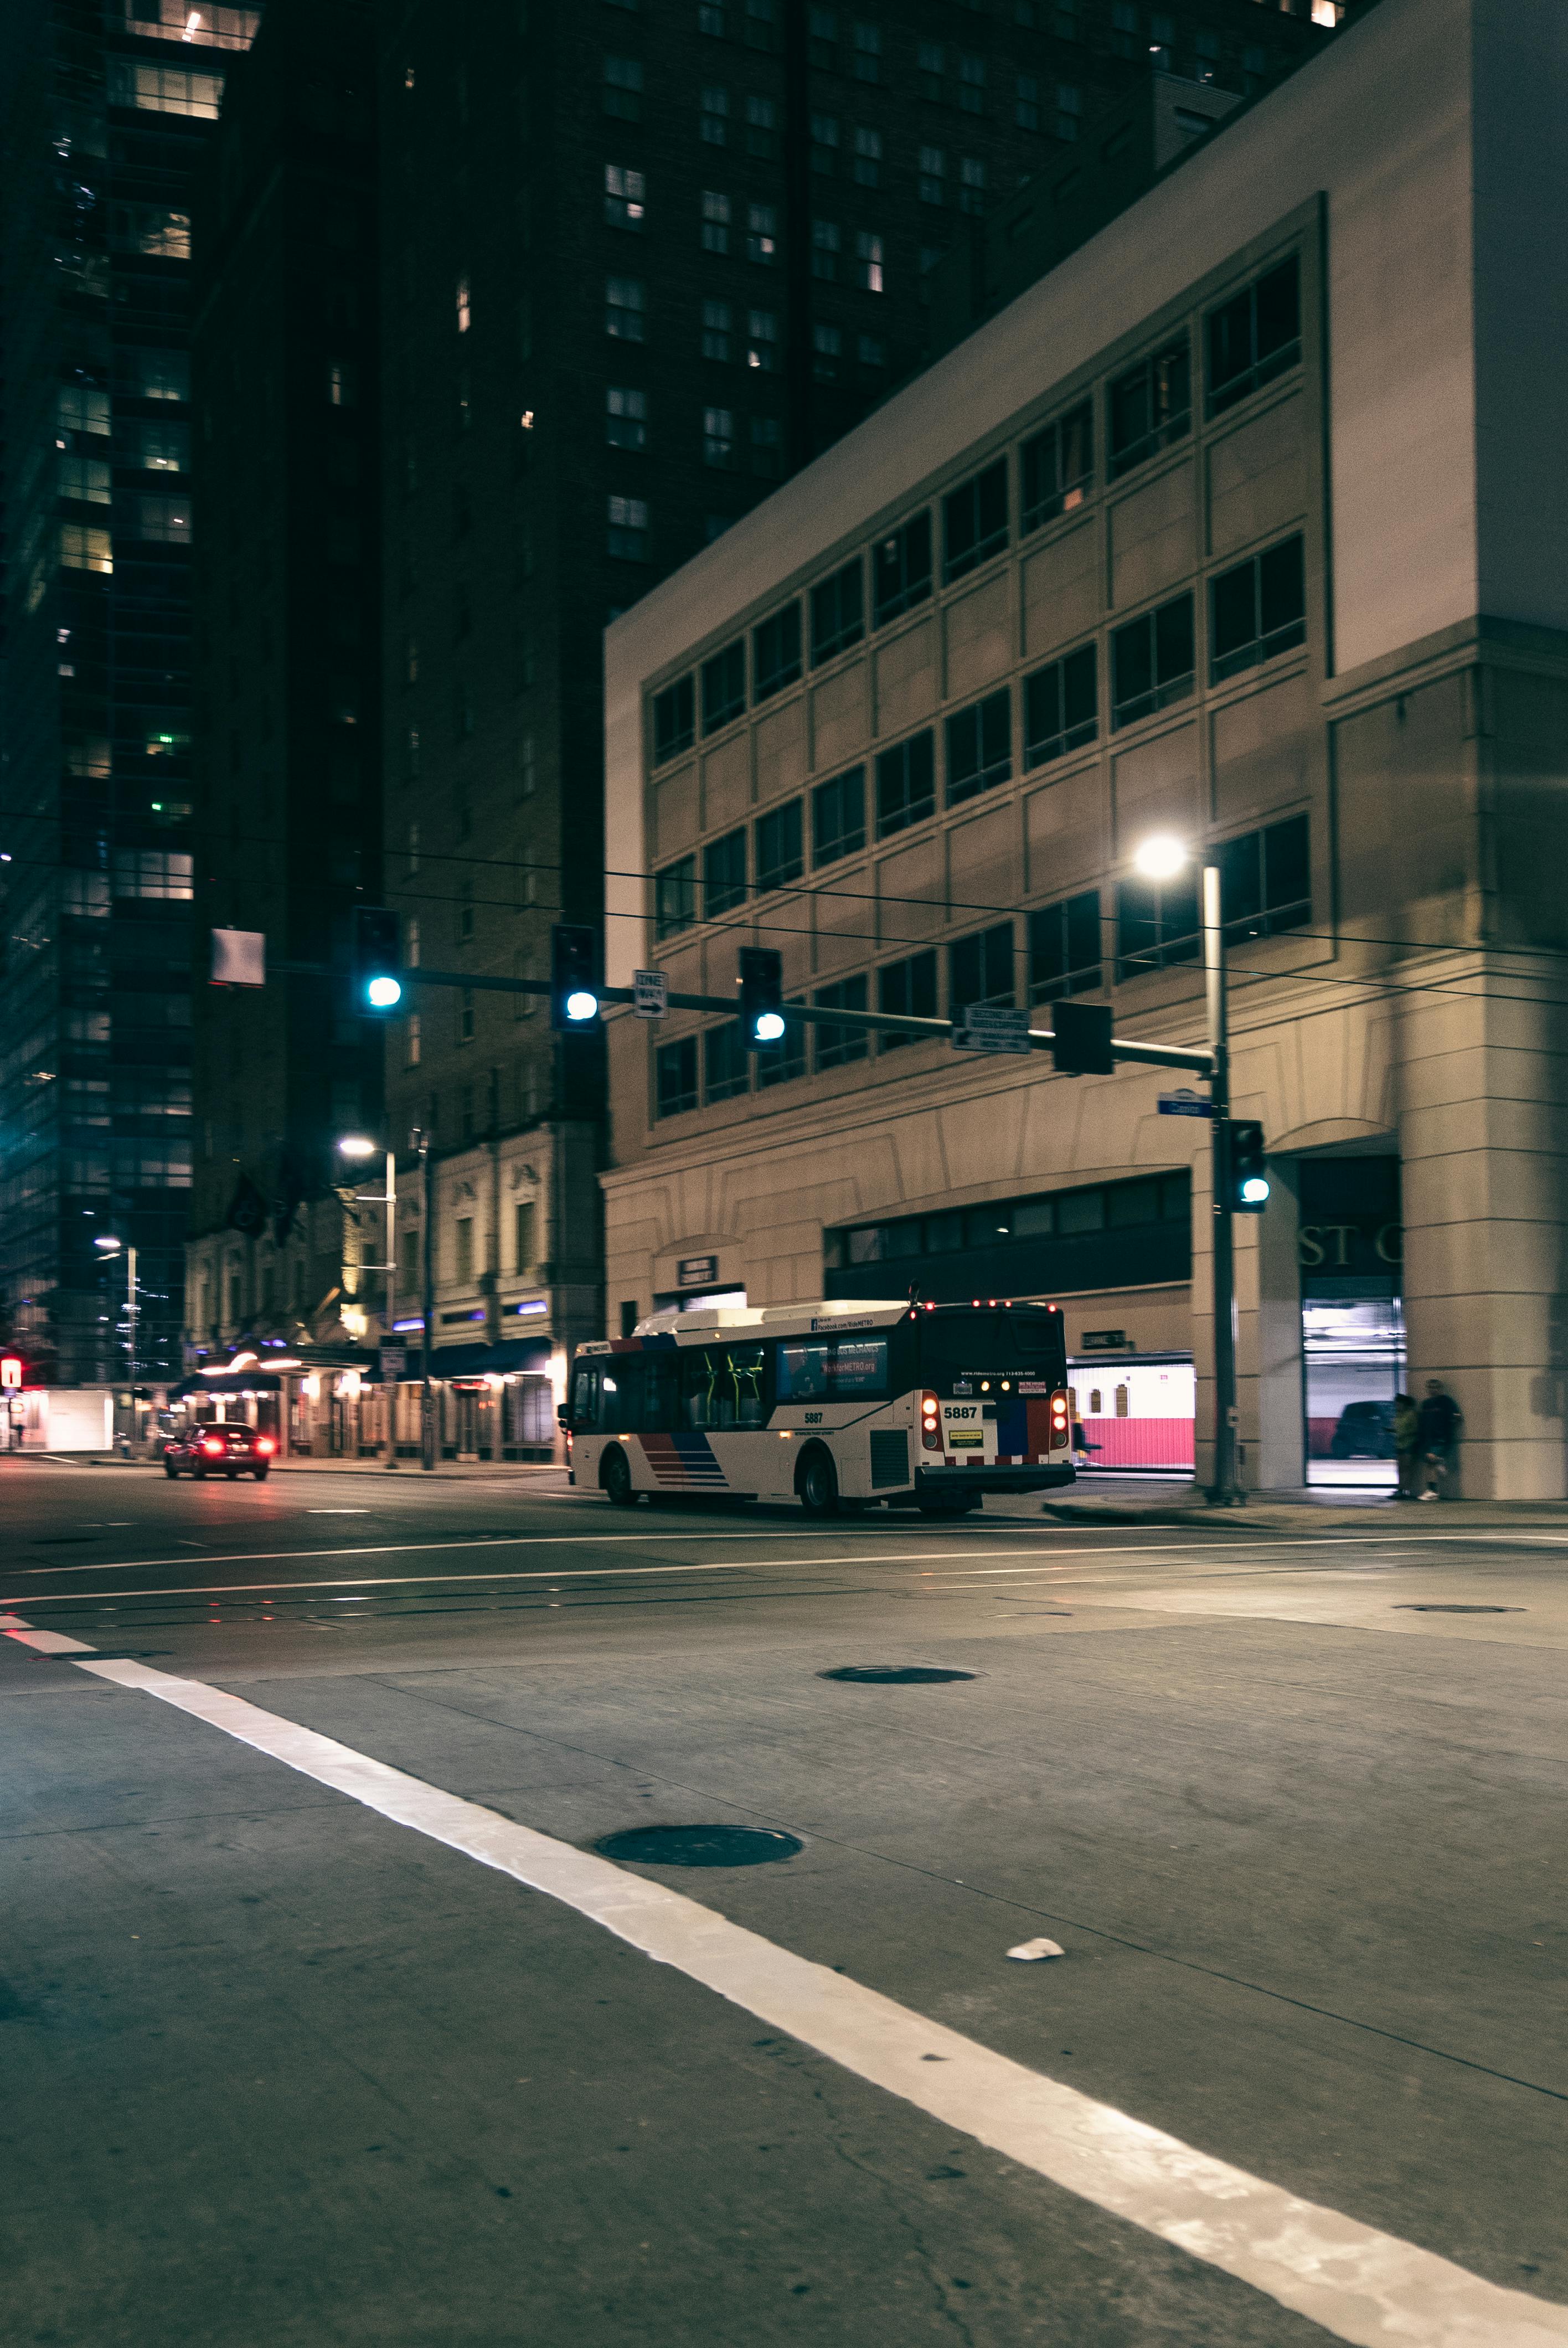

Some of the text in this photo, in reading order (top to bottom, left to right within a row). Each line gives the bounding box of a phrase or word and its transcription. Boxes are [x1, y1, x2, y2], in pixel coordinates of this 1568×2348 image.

[636, 974, 664, 987] ONE
[637, 988, 664, 1000] WAY
[804, 1412, 823, 1424] 5887
[944, 1407, 977, 1419] 5887
